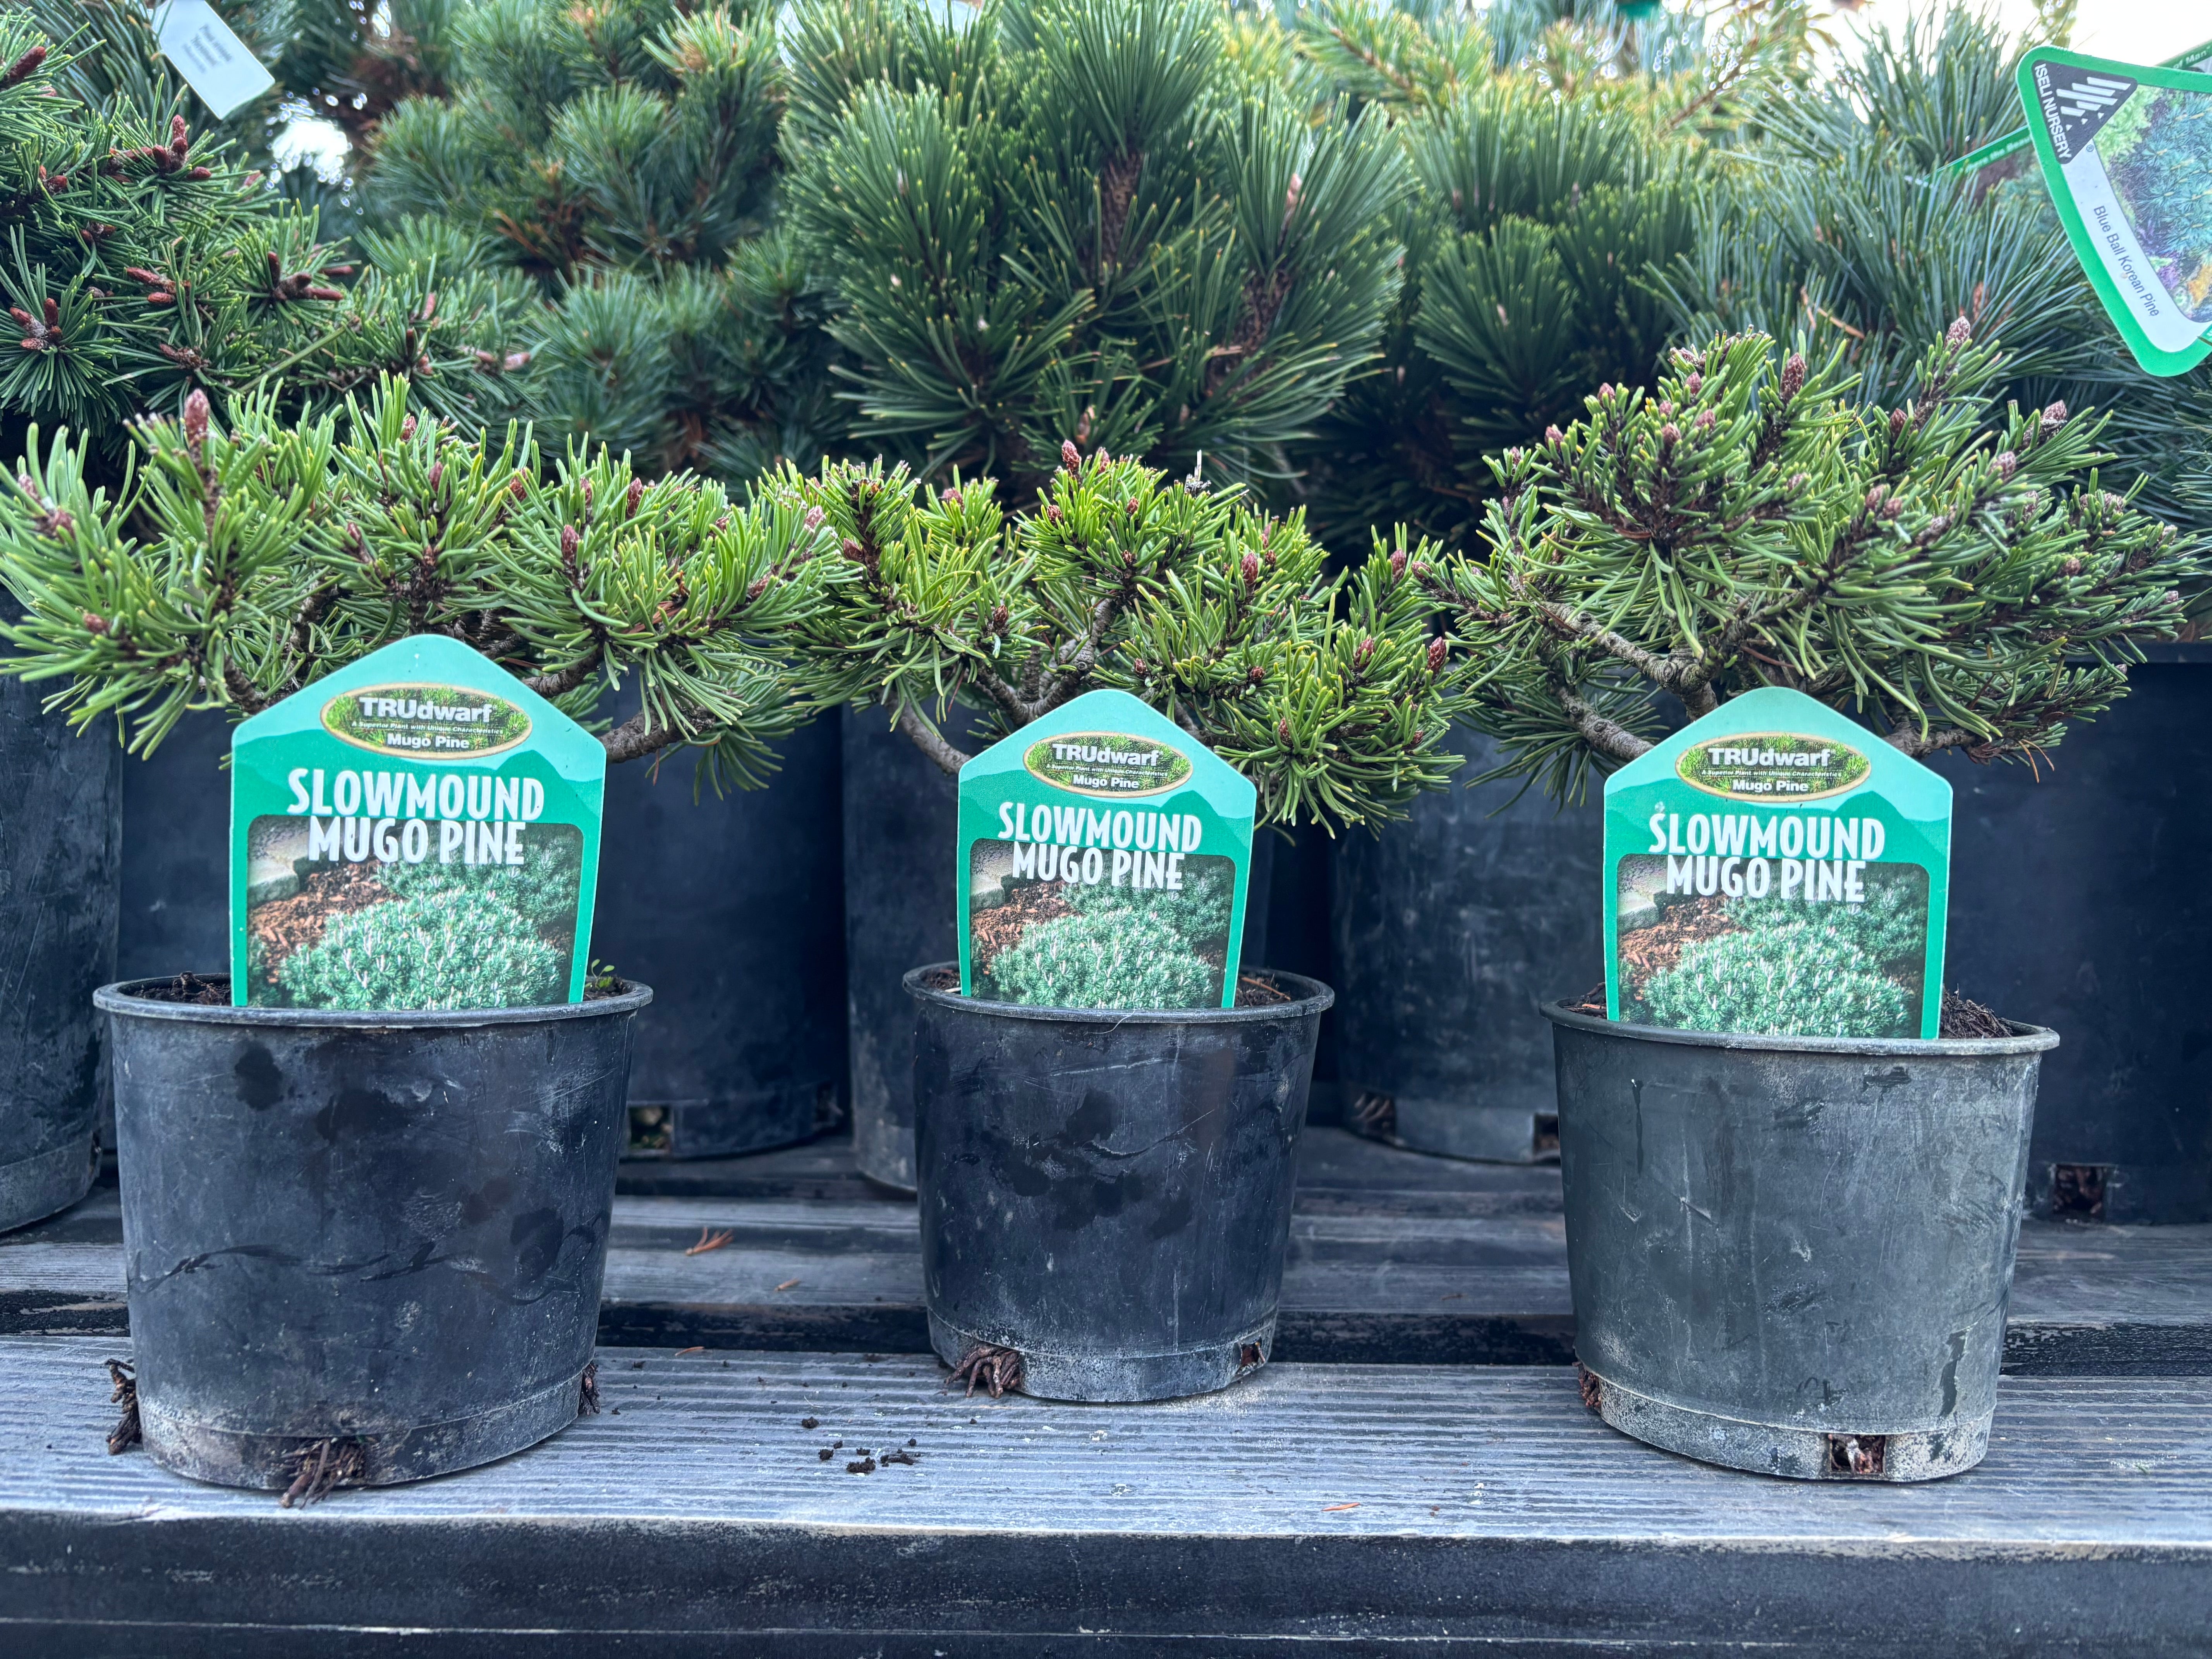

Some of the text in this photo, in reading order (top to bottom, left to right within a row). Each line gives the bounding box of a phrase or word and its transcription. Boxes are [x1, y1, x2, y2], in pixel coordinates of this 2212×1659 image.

[2035, 63, 2072, 158] ISELI NURSERY
[2094, 206, 2160, 317] Blue Ball Korean Pine
[359, 697, 492, 723] TRUdwarf
[388, 733, 470, 749] Mugo Pine
[1052, 744, 1159, 766] TRUdwarf
[1708, 748, 1831, 766] TRUdwarf
[287, 768, 544, 821] SLOWMOUND
[1073, 775, 1139, 789] Mugo Pine
[1733, 779, 1808, 793] Mugo Pine
[308, 816, 526, 865] MUGO PINE
[998, 802, 1201, 852] SLOWMOUND
[1649, 813, 1885, 860] SLOWMOUND
[1012, 841, 1185, 890] MUGO PINE
[1666, 855, 1866, 902] MUGO PINE
